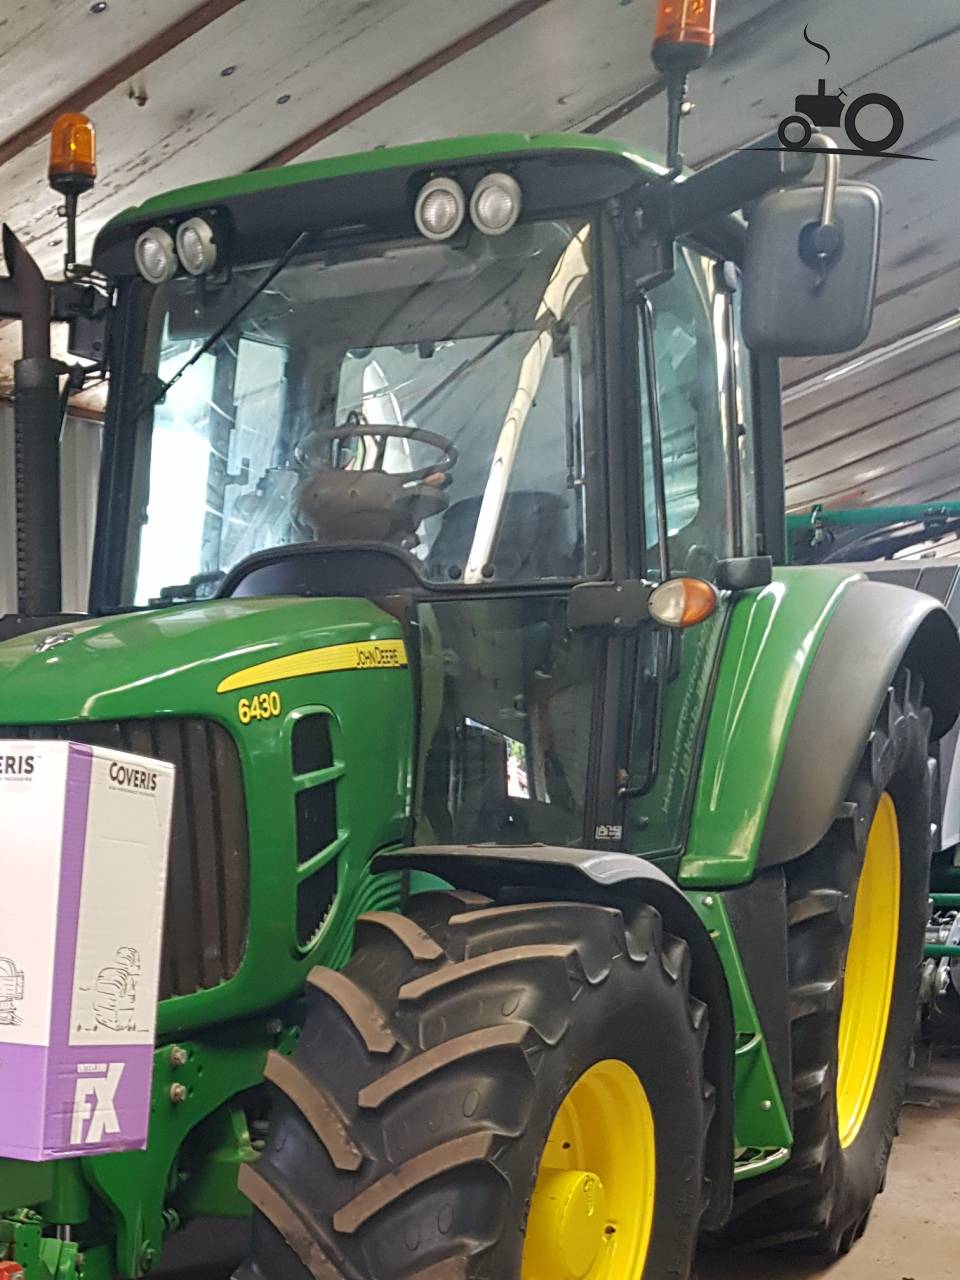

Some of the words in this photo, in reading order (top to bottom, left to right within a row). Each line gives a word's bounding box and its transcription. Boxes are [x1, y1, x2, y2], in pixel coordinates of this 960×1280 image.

[356, 648, 377, 666] JOHN
[374, 646, 399, 665] DEERE
[238, 691, 281, 724] 6430
[109, 761, 158, 791] COVERIS
[70, 1062, 126, 1145] FX
